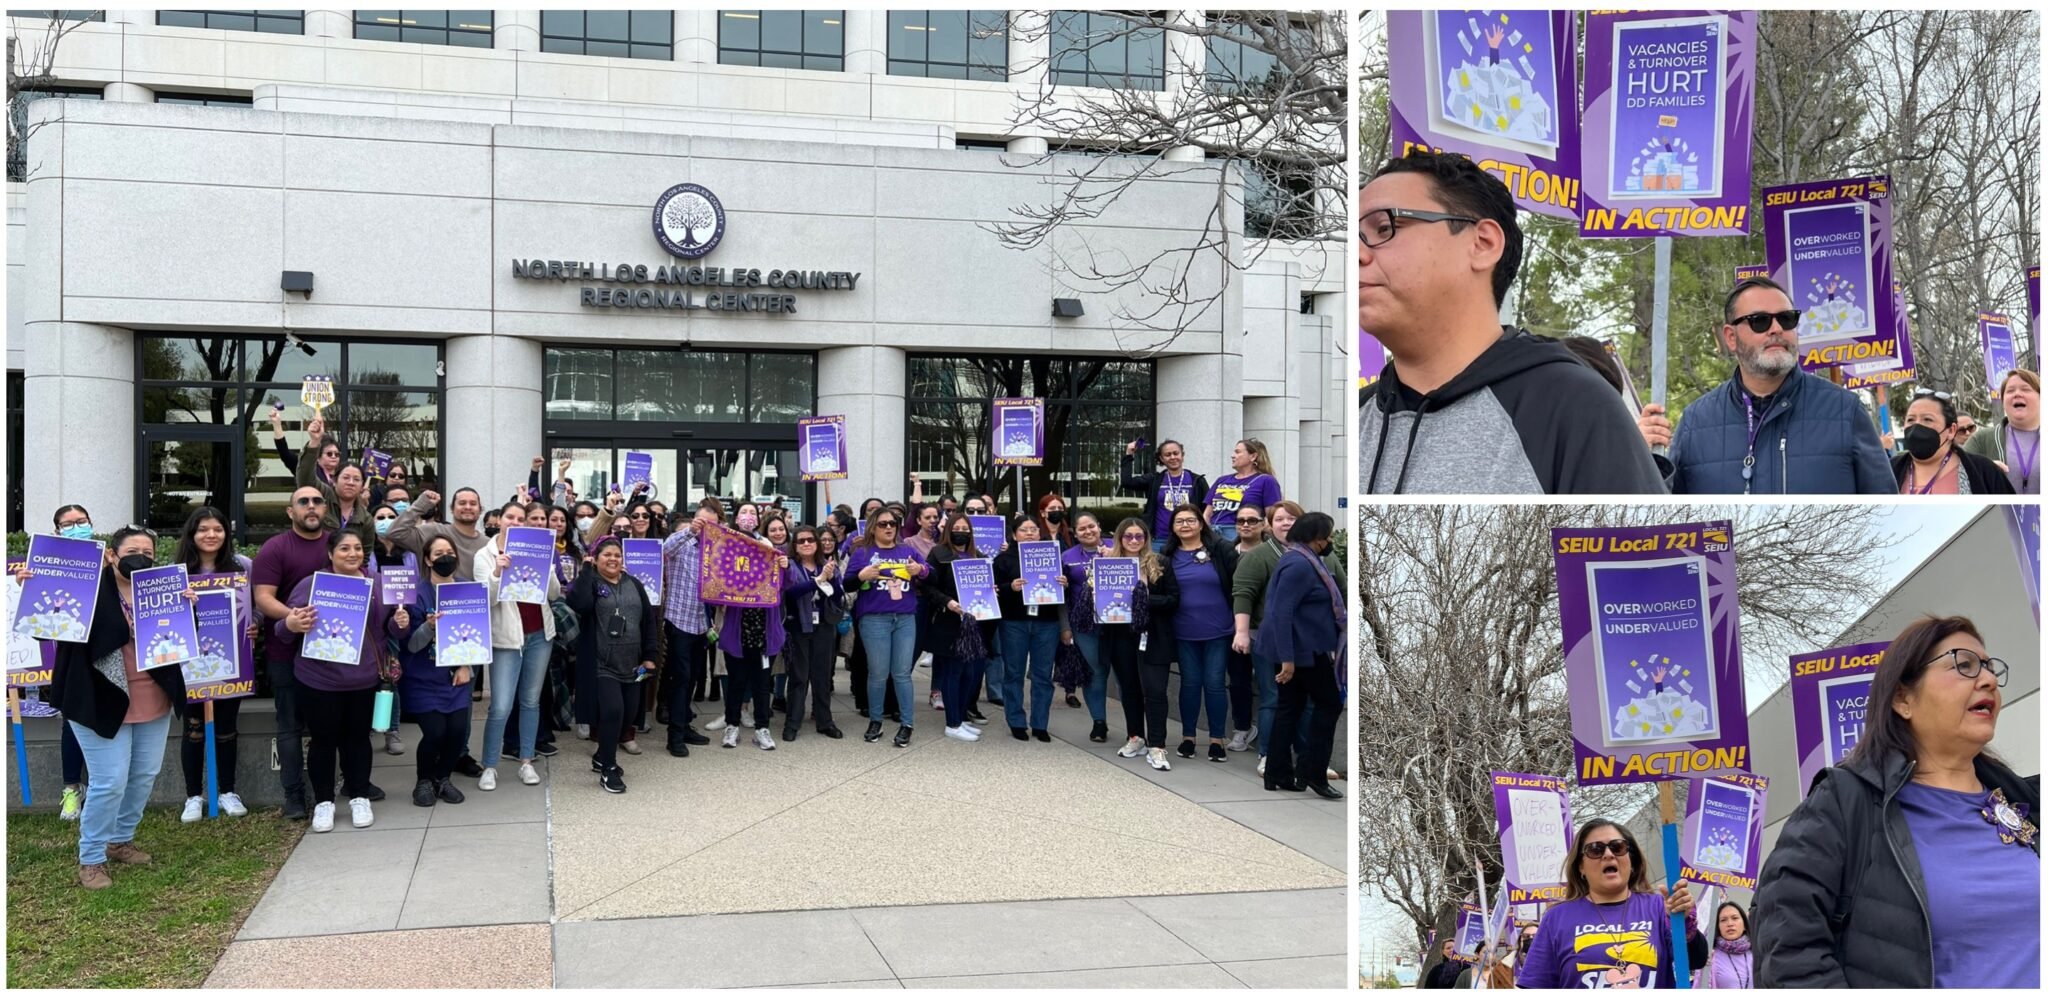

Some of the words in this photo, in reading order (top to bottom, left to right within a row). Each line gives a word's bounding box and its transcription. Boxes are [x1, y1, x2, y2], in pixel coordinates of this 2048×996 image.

[1628, 40, 1708, 56] VACANCIES
[1628, 59, 1636, 69] &
[1639, 56, 1707, 69] TURNOVER
[1628, 69, 1708, 95] HURT
[1627, 98, 1645, 108] DD
[1649, 95, 1706, 107] FAMILIES
[1463, 155, 1579, 209] TION!
[1766, 190, 1797, 206] SEIU
[1800, 186, 1836, 202] Local
[1840, 184, 1865, 198] 721
[655, 198, 666, 224] NORTH
[664, 189, 678, 200] LOS
[678, 186, 710, 198] ANGELES
[709, 196, 723, 224] COUNTY
[1584, 208, 1618, 231] IN
[1620, 205, 1747, 230] ACTION!
[660, 236, 694, 256] REGIONAL
[694, 237, 719, 254] CENTER
[1794, 231, 1861, 247] OVERWORKED
[1794, 246, 1862, 261] UNDERVALUED
[512, 259, 595, 282] NORTH
[602, 262, 648, 284] LOS
[654, 266, 762, 288] ANGELES
[768, 269, 861, 291] COUNTY
[580, 287, 698, 310] REGIONAL
[706, 292, 797, 314] CENTER
[1803, 339, 1894, 366] ACTION!
[1848, 377, 1861, 388] IN
[1864, 368, 1914, 385] ACTION!
[306, 383, 329, 392] UNION
[304, 393, 332, 402] STRONG
[813, 472, 847, 480] ACTION!
[508, 541, 552, 551] OVERWORKED
[1558, 536, 1604, 554] SEIU
[1610, 534, 1658, 552] Local
[1665, 532, 1697, 549] 721
[1704, 543, 1728, 552] SEIU
[33, 555, 98, 569] OVERWORKED
[1025, 558, 1056, 567] HURT
[30, 568, 96, 580] UNDERVALUED
[136, 575, 181, 588] VACANCIES
[960, 575, 990, 584] HURT
[1099, 576, 1134, 585] HURT
[142, 583, 182, 595] TURNOVER
[188, 578, 209, 588] ocal
[213, 577, 231, 586] 721
[876, 580, 910, 592] SU
[138, 591, 184, 611] HURT
[316, 590, 366, 602] OVERWORKED
[151, 605, 185, 616] FAMILIES
[314, 600, 365, 611] UNDERVALUED
[1604, 598, 1697, 615] OVERWORKED
[1605, 618, 1698, 634] UNDERVALUED
[1795, 657, 1835, 676] SEIU
[1840, 650, 1884, 669] Local
[6, 669, 53, 684] TION
[187, 680, 253, 700] ACTION!
[1838, 713, 1846, 721] &
[1582, 756, 1615, 779] IN
[1622, 746, 1746, 777] ACTION!
[1495, 776, 1516, 785] SEIU
[1518, 778, 1540, 787] Local
[1542, 780, 1555, 789] 721
[1739, 776, 1753, 785] 721
[1514, 798, 1554, 816] OVER-
[1706, 800, 1747, 812] OVERWORKED
[1705, 809, 1746, 821] UNDERVALUED
[1520, 843, 1563, 862] UNDER-
[1681, 867, 1698, 878] IN
[1698, 870, 1756, 889] ACTION!
[1511, 889, 1526, 902] IN
[1530, 887, 1568, 900] ACTIO
[1575, 924, 1625, 936] LOCAL
[1630, 921, 1652, 931] 721
[1581, 970, 1657, 989] SU
